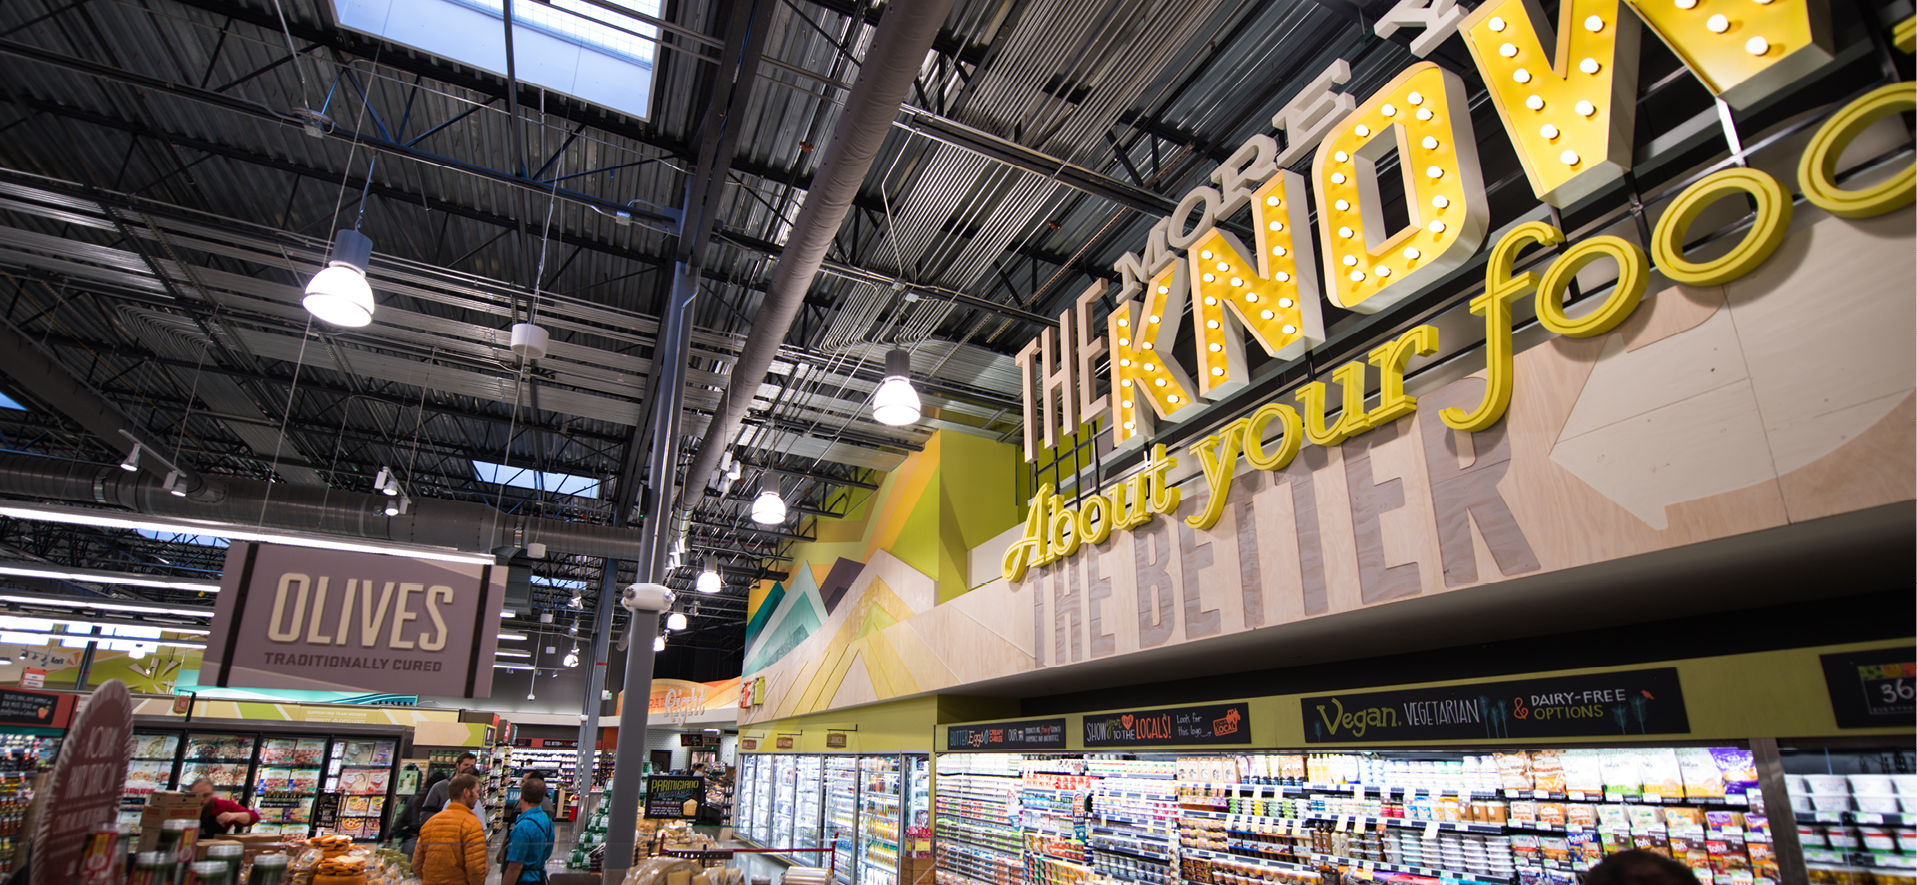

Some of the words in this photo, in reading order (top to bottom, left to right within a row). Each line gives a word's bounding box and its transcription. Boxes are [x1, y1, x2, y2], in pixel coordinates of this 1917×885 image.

[1015, 278, 1112, 463] THE
[1114, 58, 1356, 303] MORE
[1001, 443, 1181, 583] About
[1184, 325, 1439, 530] your
[1027, 538, 1115, 669] THE
[1134, 376, 1541, 649] BETTER
[268, 572, 454, 651] OLIVES
[264, 652, 390, 669] TRADITIONALLY
[392, 659, 443, 672] CURED
[664, 688, 706, 727] Right
[1403, 699, 1480, 727] VEGETARIAN
[1514, 697, 1529, 720] &
[1531, 689, 1626, 706] DAIRY-FREE
[1534, 704, 1604, 720] OPTIONS
[1136, 714, 1172, 739] LOCALS!
[1176, 714, 1190, 724] Look
[1192, 712, 1202, 723] for
[950, 729, 969, 746] BUTTER
[968, 730, 984, 747] Eggs
[1008, 728, 1018, 741] OUR
[1087, 722, 1107, 742] SHOW
[1106, 718, 1122, 739] your
[1113, 730, 1122, 740] TO
[1122, 729, 1135, 740] THE
[1178, 726, 1189, 737] this
[1190, 725, 1202, 738] logo
[1215, 723, 1237, 734] LOCAL
[651, 779, 699, 793] PARMIGIANO
[1568, 833, 1593, 844] Tofurky
